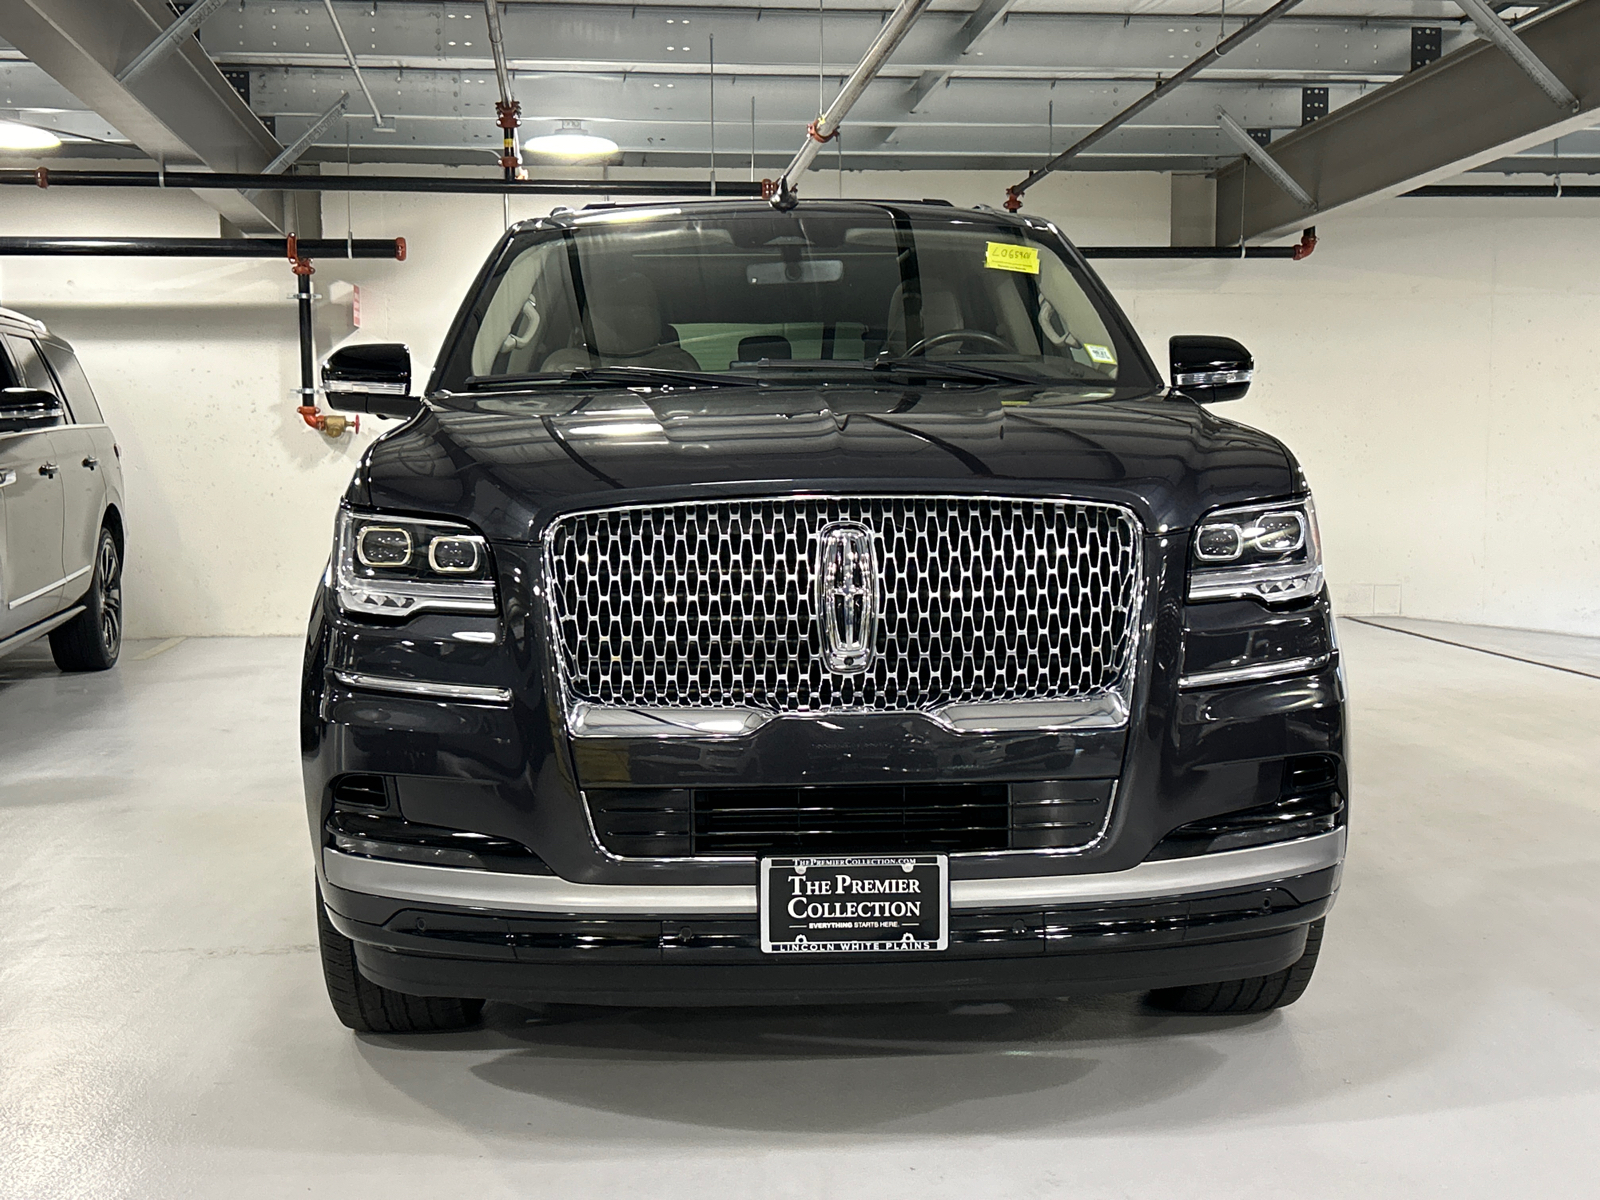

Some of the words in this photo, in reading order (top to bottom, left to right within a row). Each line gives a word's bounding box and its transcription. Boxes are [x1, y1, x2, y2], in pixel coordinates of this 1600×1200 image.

[787, 875, 832, 896] THE
[834, 874, 922, 895] PREMIER
[787, 896, 922, 919] COLLECTION
[780, 942, 835, 951] LINCOLN
[840, 942, 880, 951] WHITE
[886, 941, 930, 950] PLAINS
